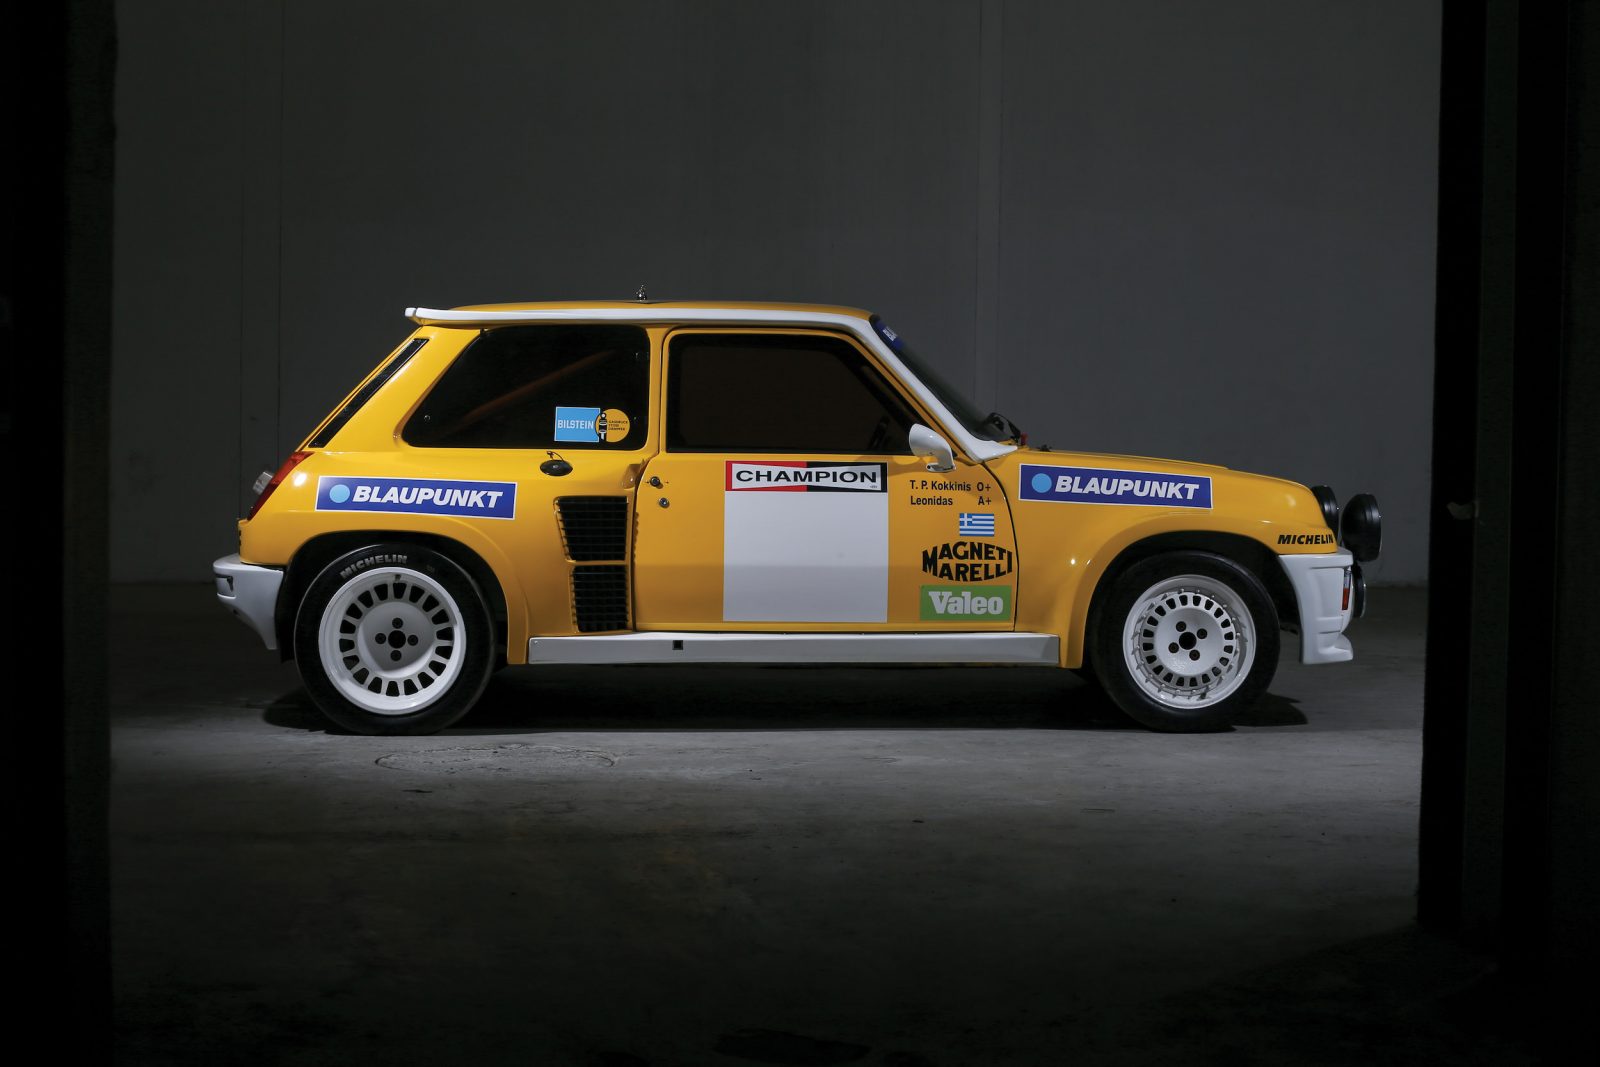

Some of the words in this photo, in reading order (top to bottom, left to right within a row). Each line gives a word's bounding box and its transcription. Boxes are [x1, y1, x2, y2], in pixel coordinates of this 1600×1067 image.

[557, 419, 594, 430] BILSTEIN
[735, 470, 877, 483] CHAMPION
[910, 479, 919, 490] T.
[921, 480, 928, 490] P.
[931, 480, 972, 492] Kokkinis
[1055, 475, 1200, 500] BLAUPUNKT
[352, 485, 503, 509] BLAUPUNKT
[910, 495, 953, 506] Leonidas
[1277, 534, 1334, 545] MICHELIN
[922, 541, 1013, 568] MAGNETI
[339, 554, 408, 580] MICHELIN
[922, 555, 1013, 582] MARELLI
[928, 591, 1004, 615] Valeo
